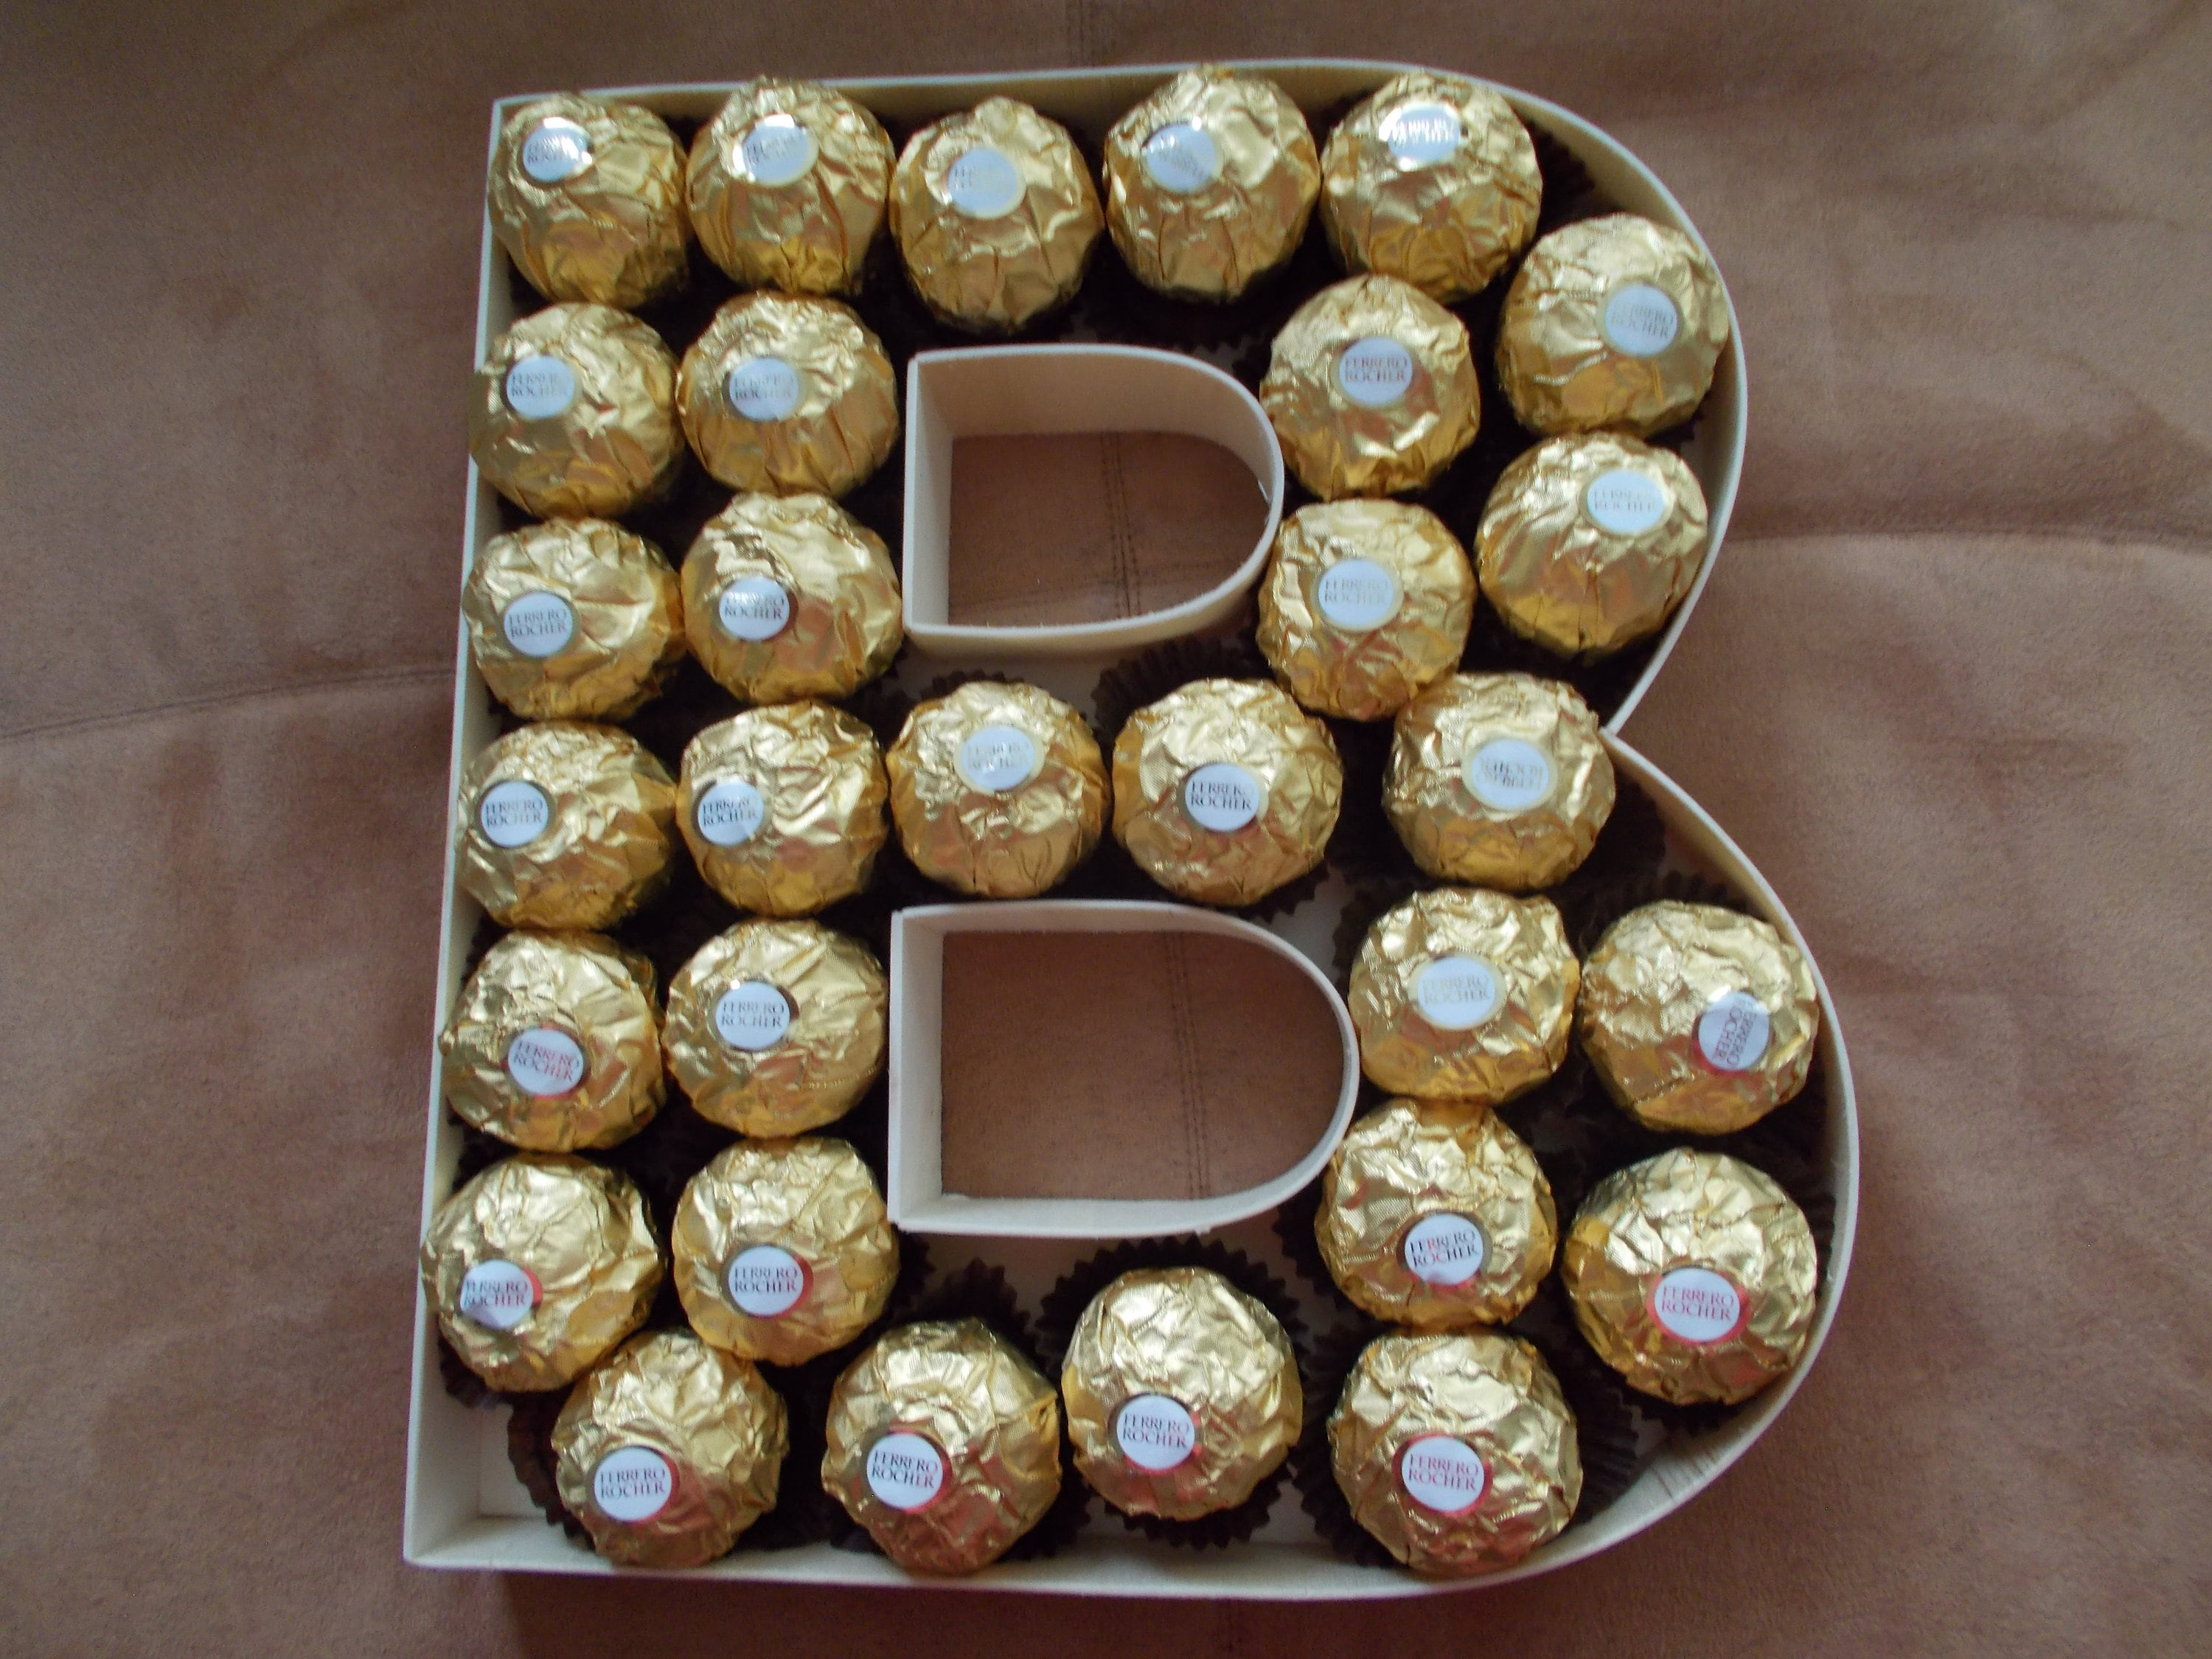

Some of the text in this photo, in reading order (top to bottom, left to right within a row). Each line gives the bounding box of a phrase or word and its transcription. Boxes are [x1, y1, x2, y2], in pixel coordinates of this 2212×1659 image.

[1346, 356, 1408, 369] FERRERO
[512, 372, 567, 384] FERRER
[1345, 370, 1405, 383] ROCHER
[509, 609, 567, 625] FERRERO
[725, 605, 782, 619] ROCHER
[510, 623, 566, 638] ROCHER
[485, 799, 543, 815] FERRERO
[702, 797, 758, 814] FERRER
[1191, 796, 1251, 811] ROCHER
[487, 815, 542, 828] ROCHER
[723, 1001, 785, 1015] FERRERO
[722, 1015, 782, 1028] ROCHER
[518, 1040, 580, 1068] FERRERO
[515, 1054, 573, 1081] ROCHER
[1411, 1231, 1475, 1253] FERRERO
[1413, 1244, 1478, 1266] ROCHER
[735, 1267, 797, 1278] FERRERO
[465, 1280, 528, 1292] FERRERO
[735, 1279, 796, 1293] ROCHER
[463, 1293, 526, 1306] ROCHER
[1663, 1286, 1734, 1306] FERRERO
[1662, 1299, 1731, 1321] ROCHER
[1124, 1413, 1189, 1434] FERRERO
[1123, 1427, 1187, 1448] ROCHER
[874, 1451, 938, 1470] FERRERO
[1410, 1454, 1478, 1475] FERRERO
[600, 1468, 665, 1483] FERRERO
[872, 1466, 933, 1488] ROCHER
[1408, 1469, 1476, 1491] ROCHER
[602, 1481, 667, 1499] ROCHER
